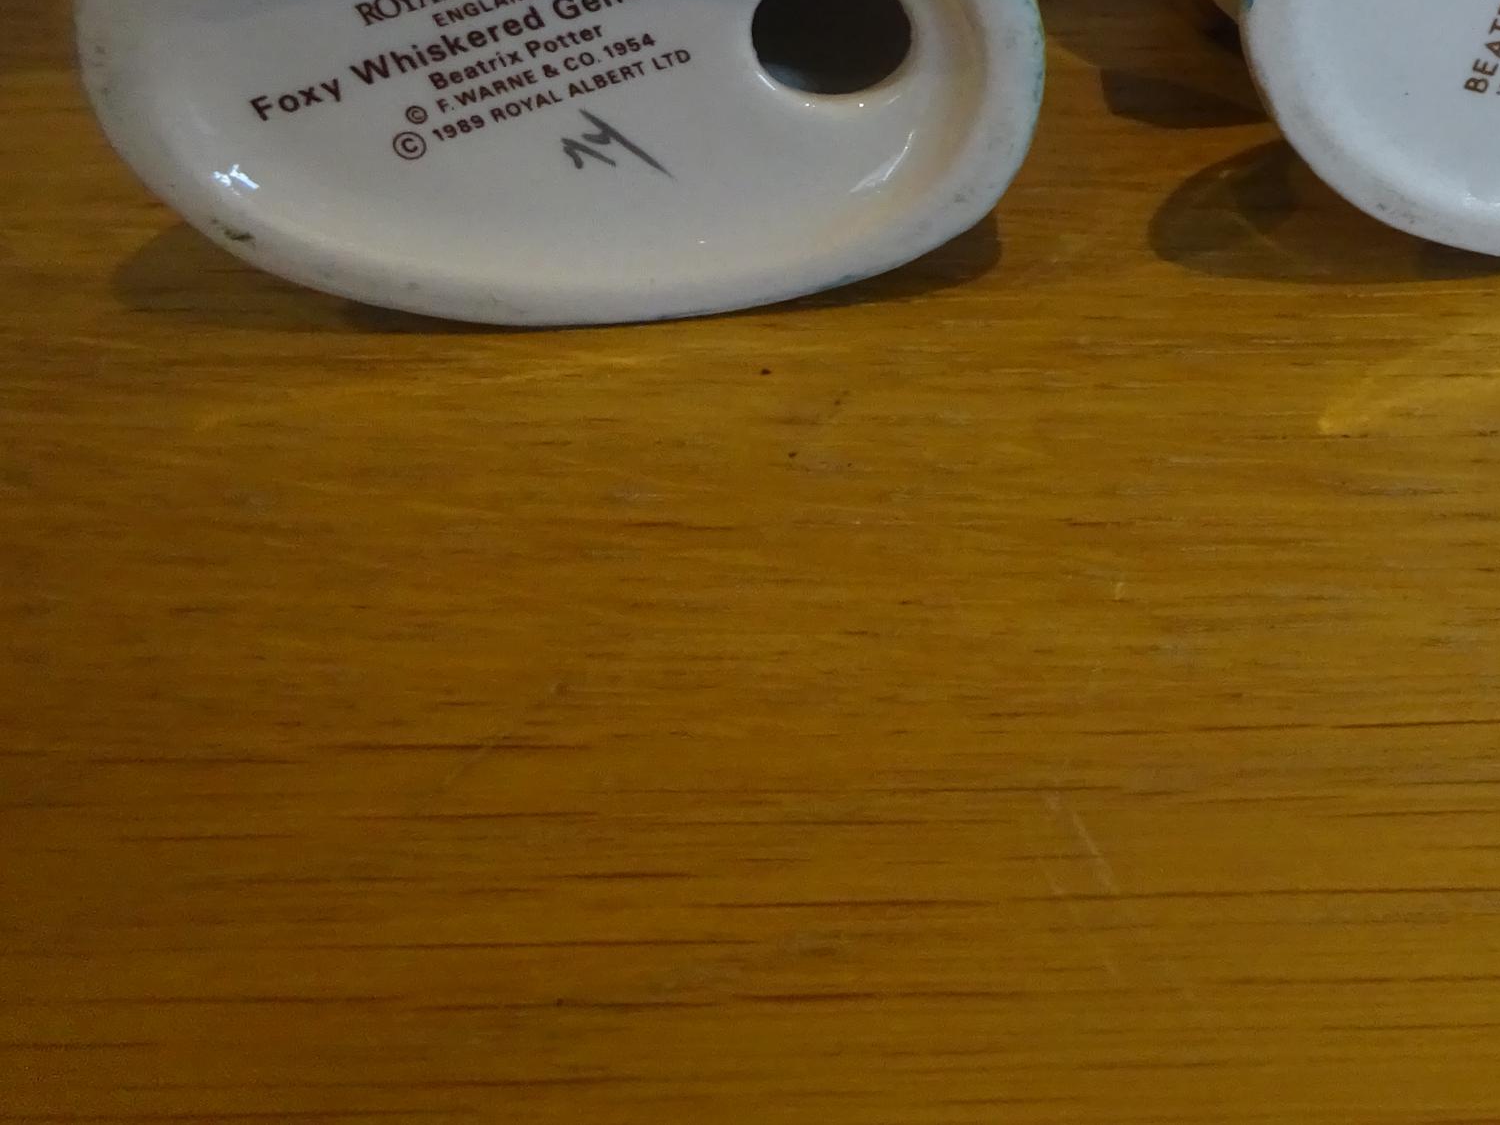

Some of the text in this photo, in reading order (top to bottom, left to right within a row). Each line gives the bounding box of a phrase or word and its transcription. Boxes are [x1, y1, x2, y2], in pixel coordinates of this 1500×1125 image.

[248, 76, 343, 122] Foxy
[349, 6, 545, 85] Whiskered
[429, 24, 605, 90] Beatrix Potter
[431, 114, 486, 142] 1989
[490, 89, 563, 124] ROYAL
[567, 61, 647, 98] ALBERT
[651, 48, 692, 72] LTD
[542, 63, 561, 79] &
[602, 33, 657, 60] 1954
